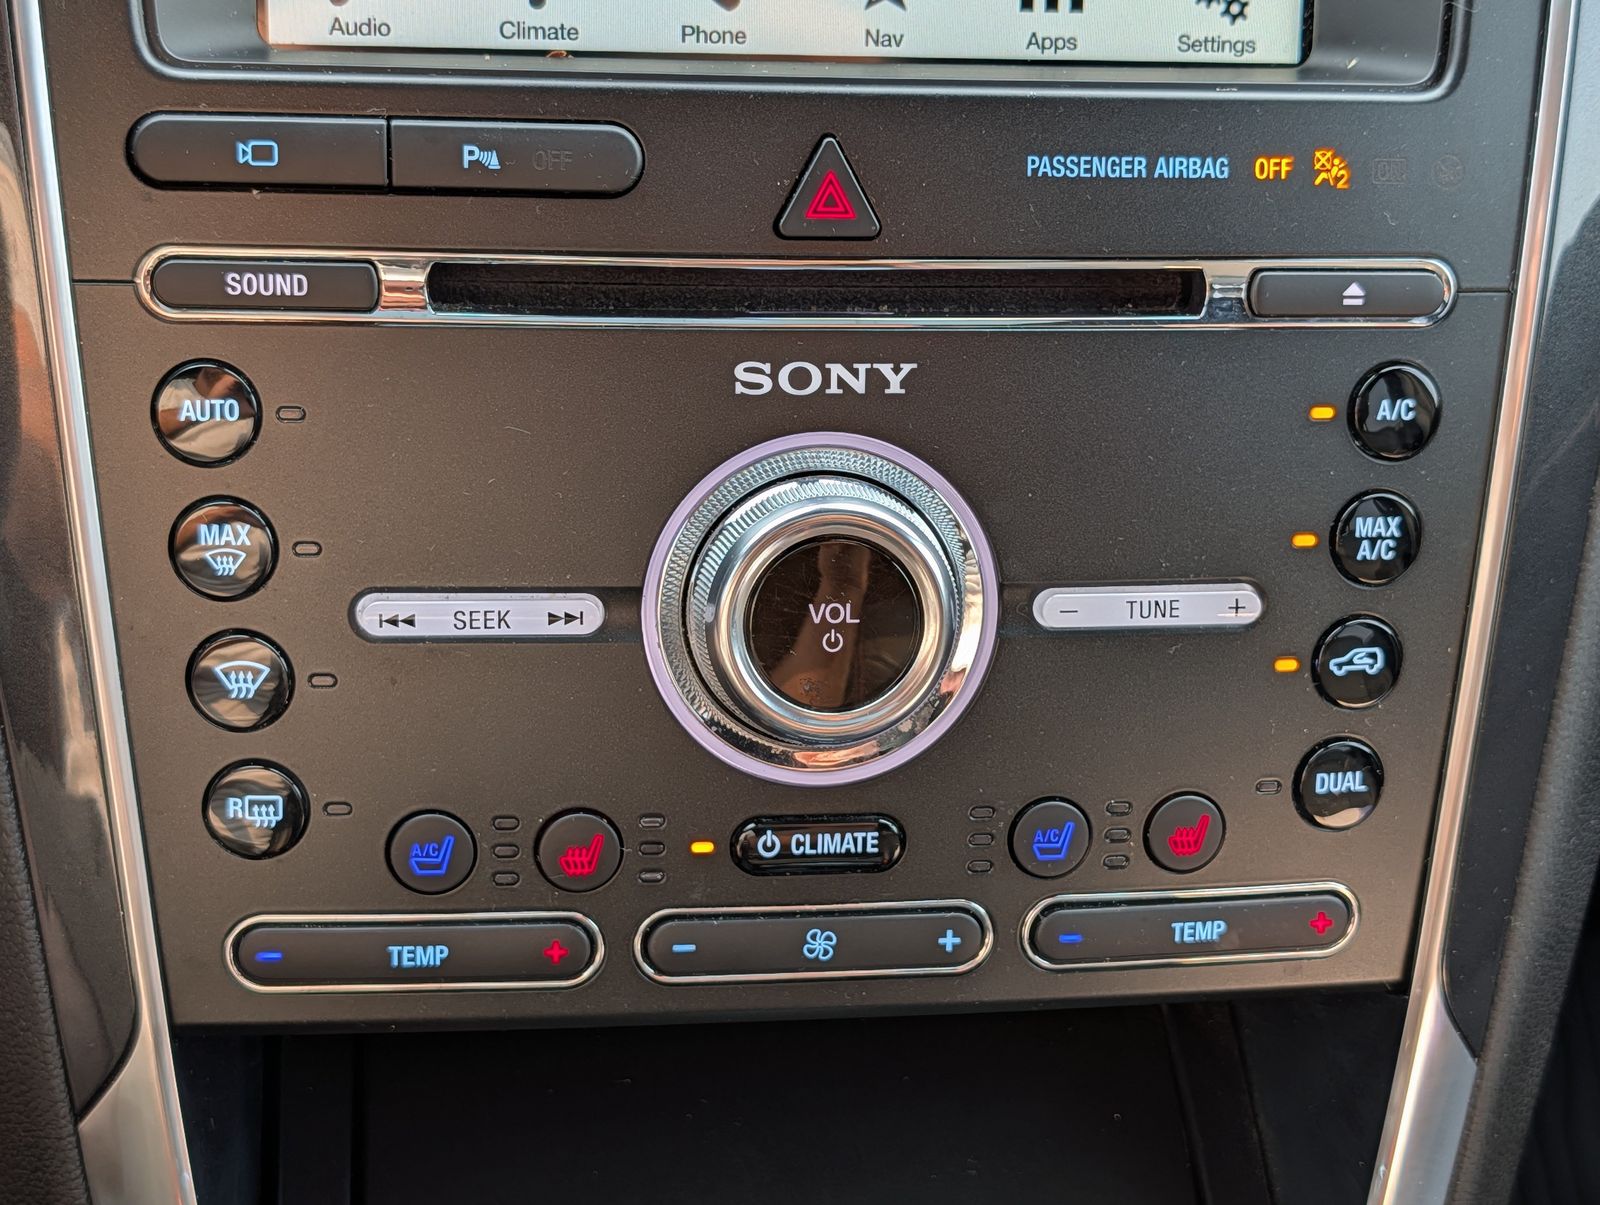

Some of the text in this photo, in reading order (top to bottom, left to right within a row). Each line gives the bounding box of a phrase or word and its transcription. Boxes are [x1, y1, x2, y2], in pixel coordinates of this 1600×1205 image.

[328, 17, 392, 38] Audio
[498, 20, 580, 42] Climate
[680, 25, 748, 45] Phone
[864, 28, 905, 48] Nav
[1025, 31, 1079, 52] Apps
[1176, 34, 1257, 55] Settings
[532, 149, 574, 172] OFF
[1026, 155, 1294, 182] PASSENGER AIRBAG OFF
[224, 273, 308, 298] SOUND
[733, 361, 918, 396] SONY
[178, 399, 240, 422] AUTO
[1376, 398, 1417, 422] A/C
[199, 523, 252, 546] MAX
[1354, 516, 1402, 538] MAX
[1356, 539, 1398, 562] A/C
[452, 609, 512, 631] SEEK
[808, 602, 861, 625] VOL
[1125, 600, 1181, 621] TUNE
[1315, 771, 1368, 796] DUAL
[790, 831, 880, 856] CLIMATE
[1033, 828, 1060, 844] A/C
[410, 842, 440, 858] A/C
[1171, 920, 1227, 943] TEMP
[387, 945, 449, 968] TEMP
